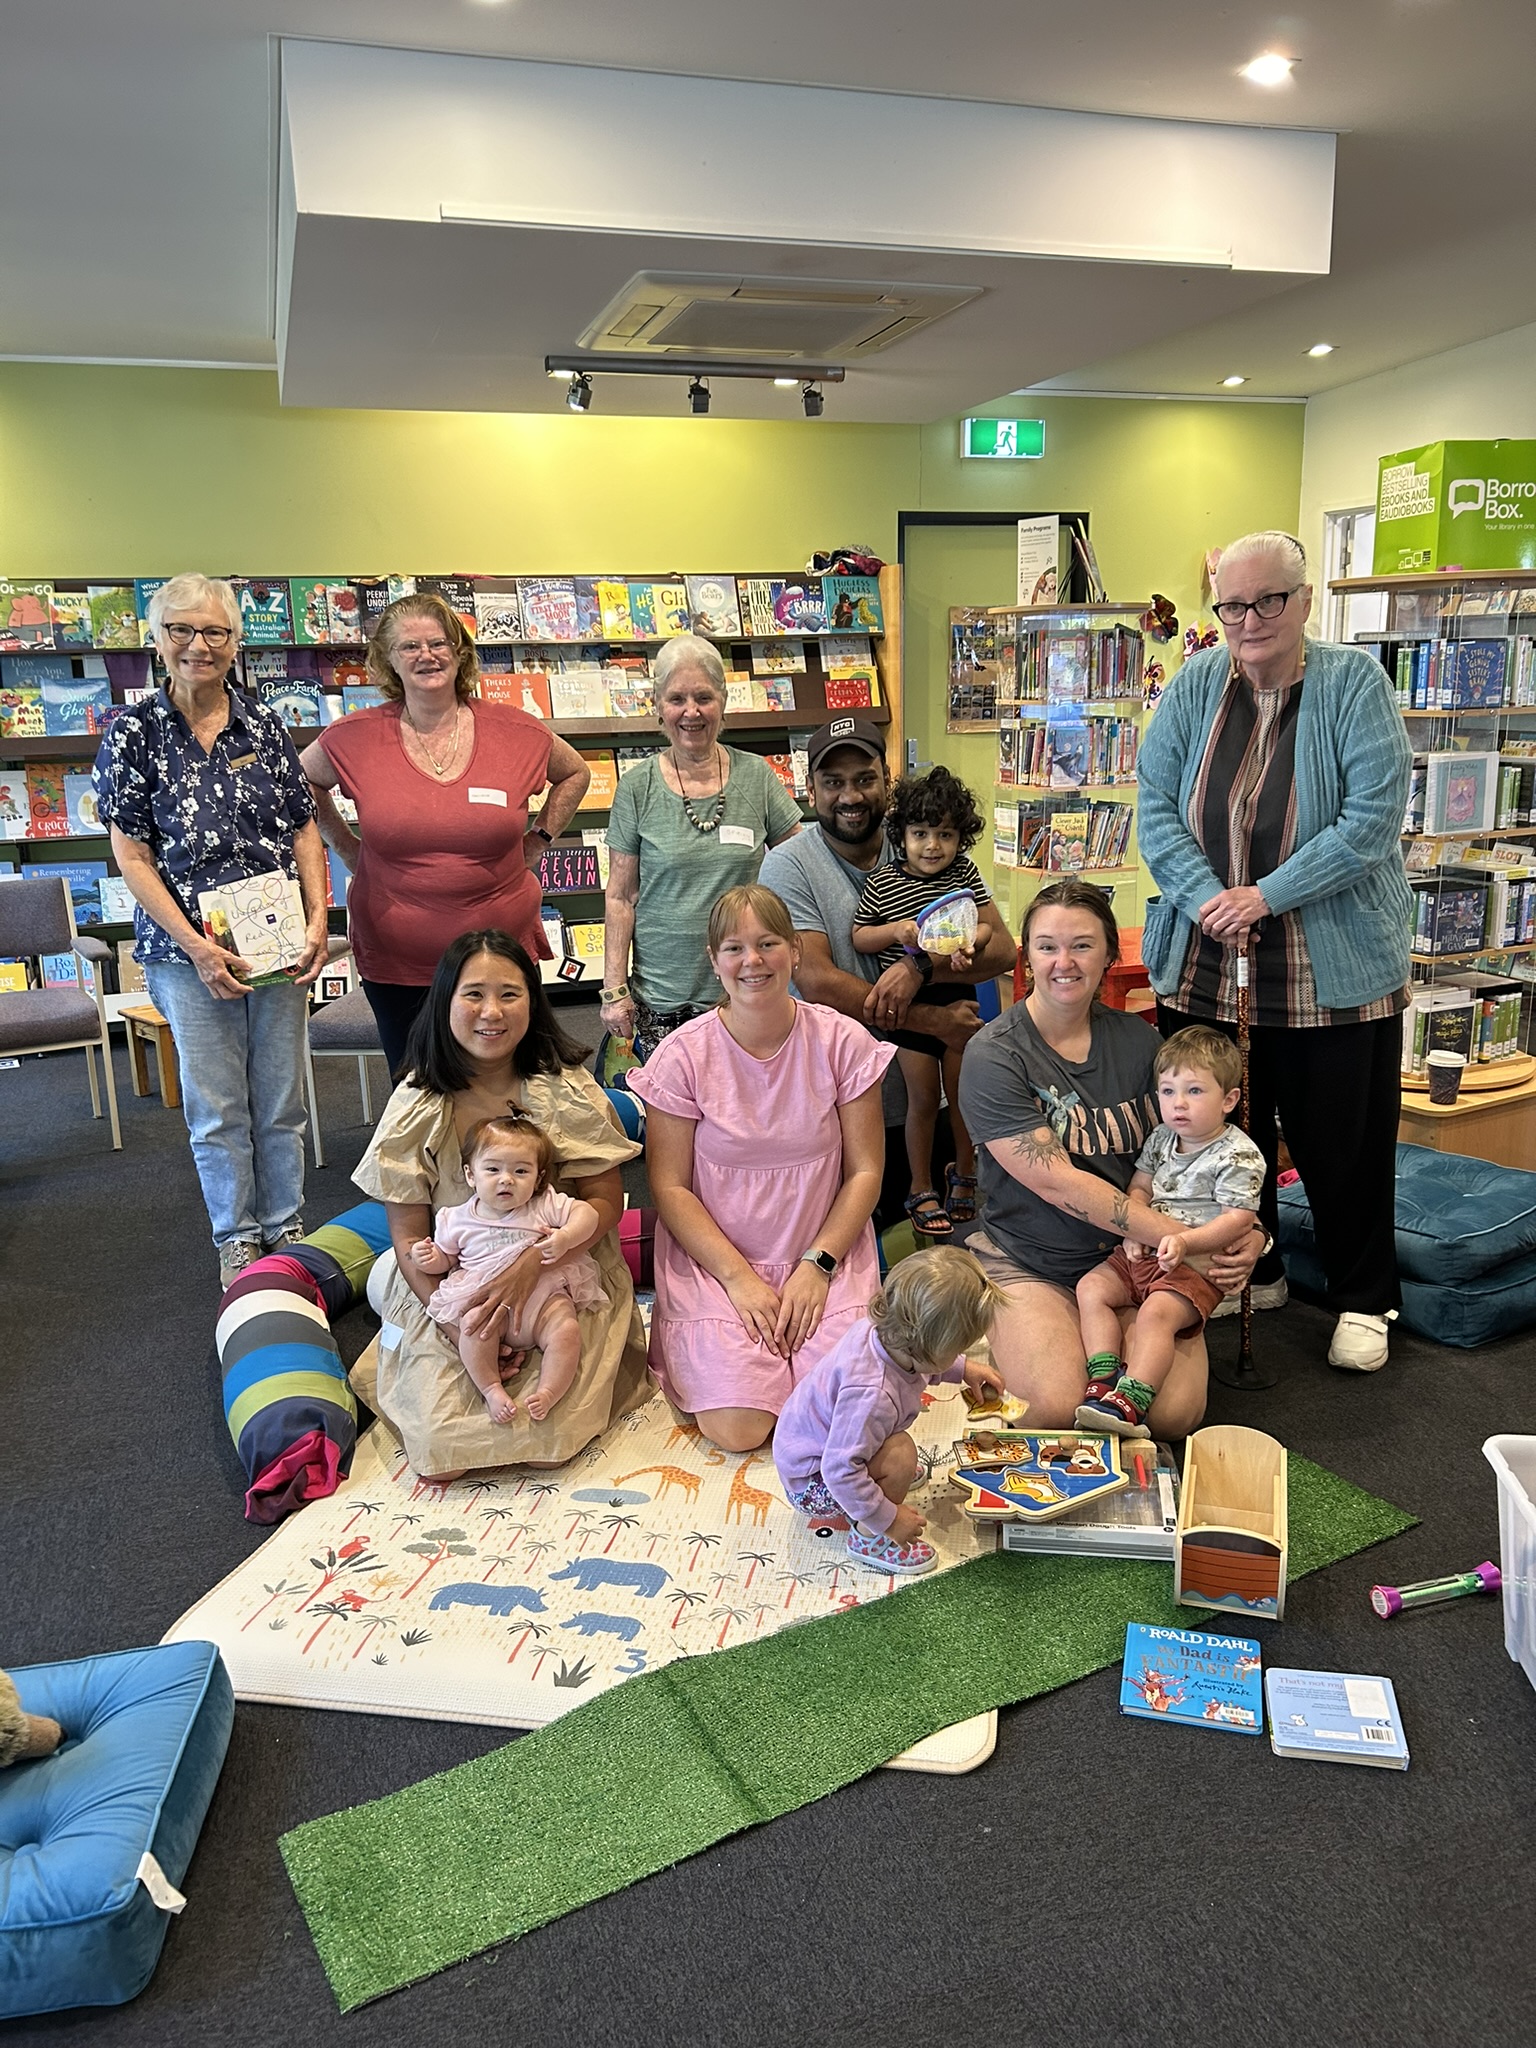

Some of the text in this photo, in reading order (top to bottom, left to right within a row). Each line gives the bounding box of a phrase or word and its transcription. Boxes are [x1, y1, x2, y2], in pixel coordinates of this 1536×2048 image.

[1383, 466, 1414, 483] BORROW
[1382, 474, 1428, 495] BESTSELLING
[1486, 479, 1536, 498] Borro
[1381, 488, 1428, 508] EBOOKS AND
[1380, 499, 1434, 520] EAUDIOBOOKS
[1485, 500, 1524, 519] Box.
[35, 584, 53, 595] GO
[440, 581, 457, 590] Eyes
[53, 597, 83, 606] MUCKY
[268, 592, 284, 613] Z
[451, 594, 473, 602] Speak
[793, 600, 826, 616] BRRR!
[248, 614, 278, 623] STORY
[11, 657, 35, 667] How
[261, 681, 289, 701] Peace
[294, 680, 322, 698] Earth
[485, 678, 512, 687] THERE'S
[487, 691, 512, 699] MOUSE
[39, 867, 92, 877] Remembering
[540, 856, 596, 872] BEGIN
[541, 871, 597, 888] AGAIN
[1056, 1521, 1087, 1529] Wooden
[1149, 1627, 1253, 1652] ROALD DAHL
[1180, 1645, 1212, 1660] Dad
[1217, 1653, 1231, 1663] is
[1278, 1676, 1306, 1685] That's
[1308, 1678, 1326, 1687] not
